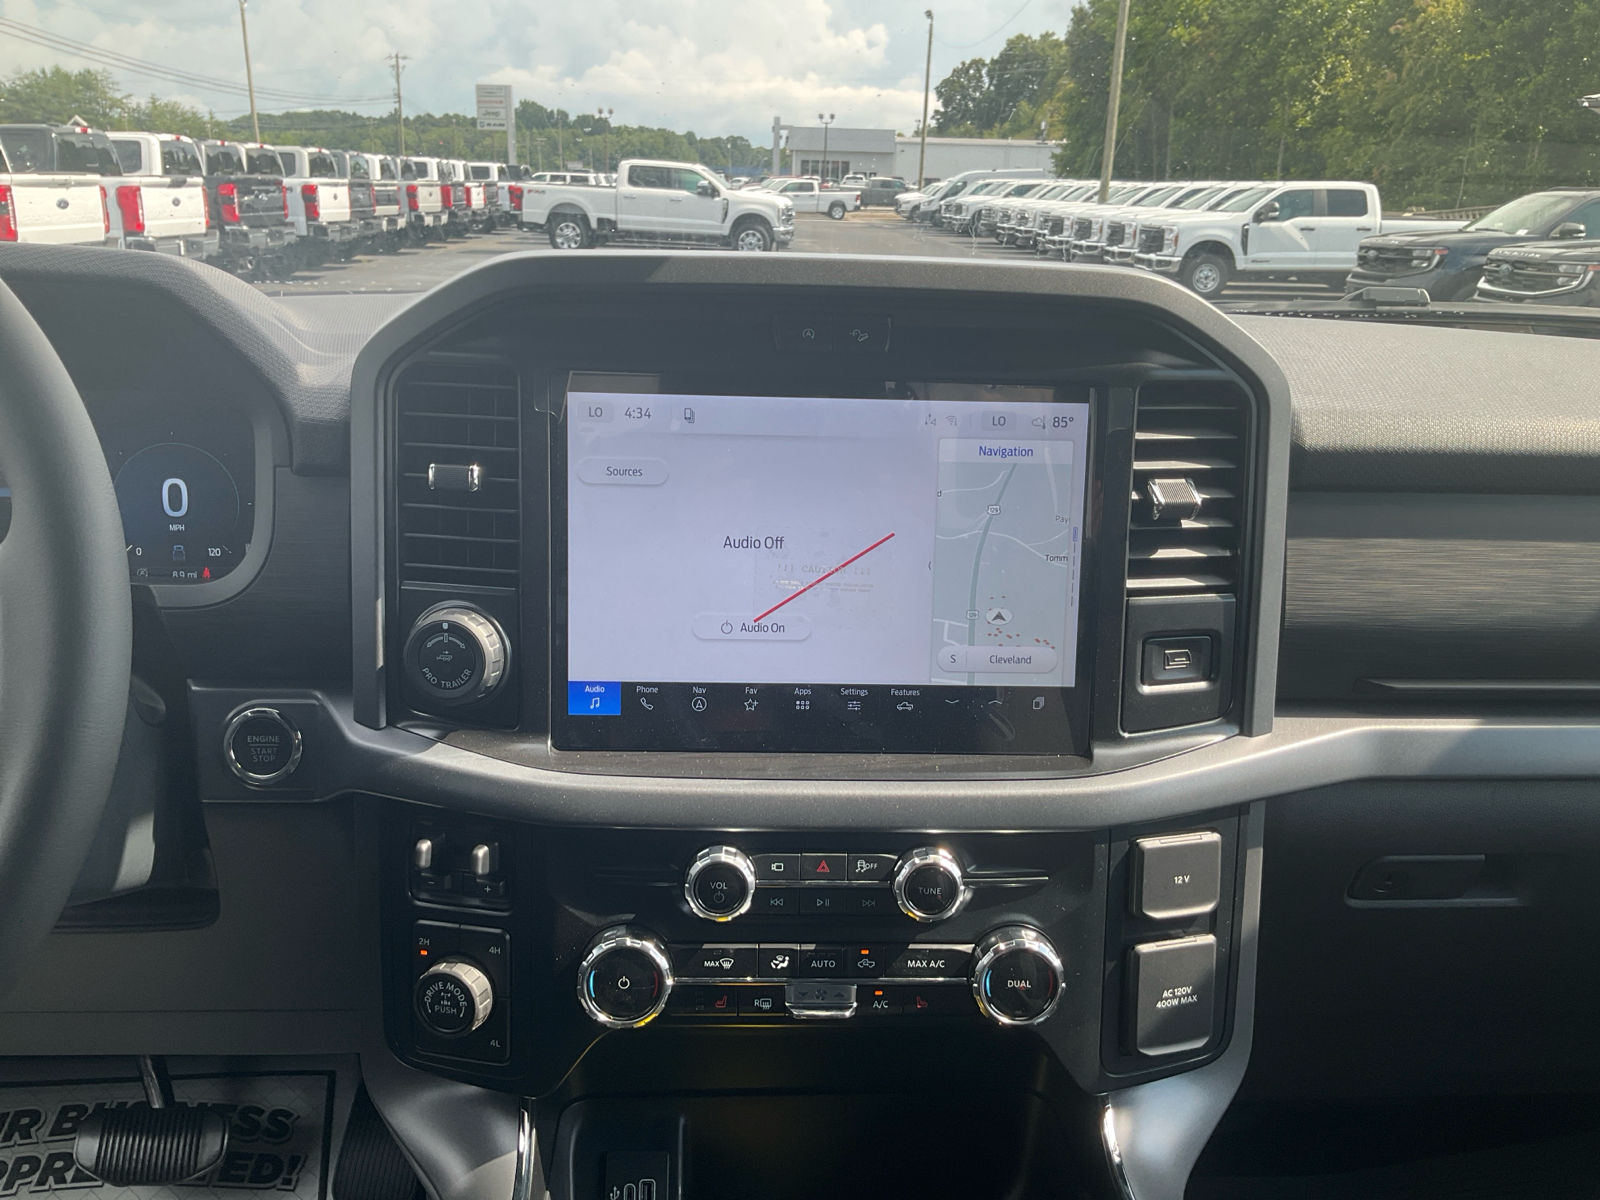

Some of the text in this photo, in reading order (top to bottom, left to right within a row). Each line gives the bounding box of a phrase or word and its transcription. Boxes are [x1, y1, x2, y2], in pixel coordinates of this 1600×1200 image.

[588, 406, 603, 418] LO
[624, 407, 652, 419] 4:34
[992, 416, 1007, 427] LO
[1052, 416, 1075, 428] 85°
[978, 445, 1034, 459] Navigation
[606, 466, 643, 477] Sources
[161, 477, 189, 518] 0
[169, 524, 185, 532] MPH
[723, 535, 785, 550] Audio Off
[135, 547, 143, 556] 0
[207, 547, 222, 557] 120
[740, 622, 785, 633] Audio On
[950, 654, 957, 664] S
[989, 655, 1032, 665] Cleveland
[422, 667, 472, 688] PRO TRAILER
[584, 685, 605, 693] Audio
[636, 685, 659, 694] Phone
[692, 686, 707, 694] Nav
[745, 687, 758, 695] Fav
[794, 687, 812, 696] Apps
[840, 687, 869, 697] Settings
[890, 688, 920, 697] Features
[247, 735, 280, 743] ENGINE
[251, 747, 278, 755] START
[866, 862, 878, 870] OFF
[1174, 876, 1183, 884] 12
[710, 881, 728, 890] VOL
[918, 886, 942, 895] TUNE
[418, 937, 430, 946] 2H
[489, 946, 501, 955] 4H
[811, 960, 836, 968] AUTO
[907, 959, 946, 968] MAX A/C
[1007, 980, 1032, 988] DUAL
[424, 981, 468, 1007] DRIVE MODE
[1162, 986, 1192, 998] AC 120V
[754, 999, 760, 1007] R
[872, 1000, 889, 1009] A/C
[1156, 995, 1198, 1008] 400W MAX
[434, 1005, 457, 1014] PUSH
[490, 1039, 501, 1048] 4L
